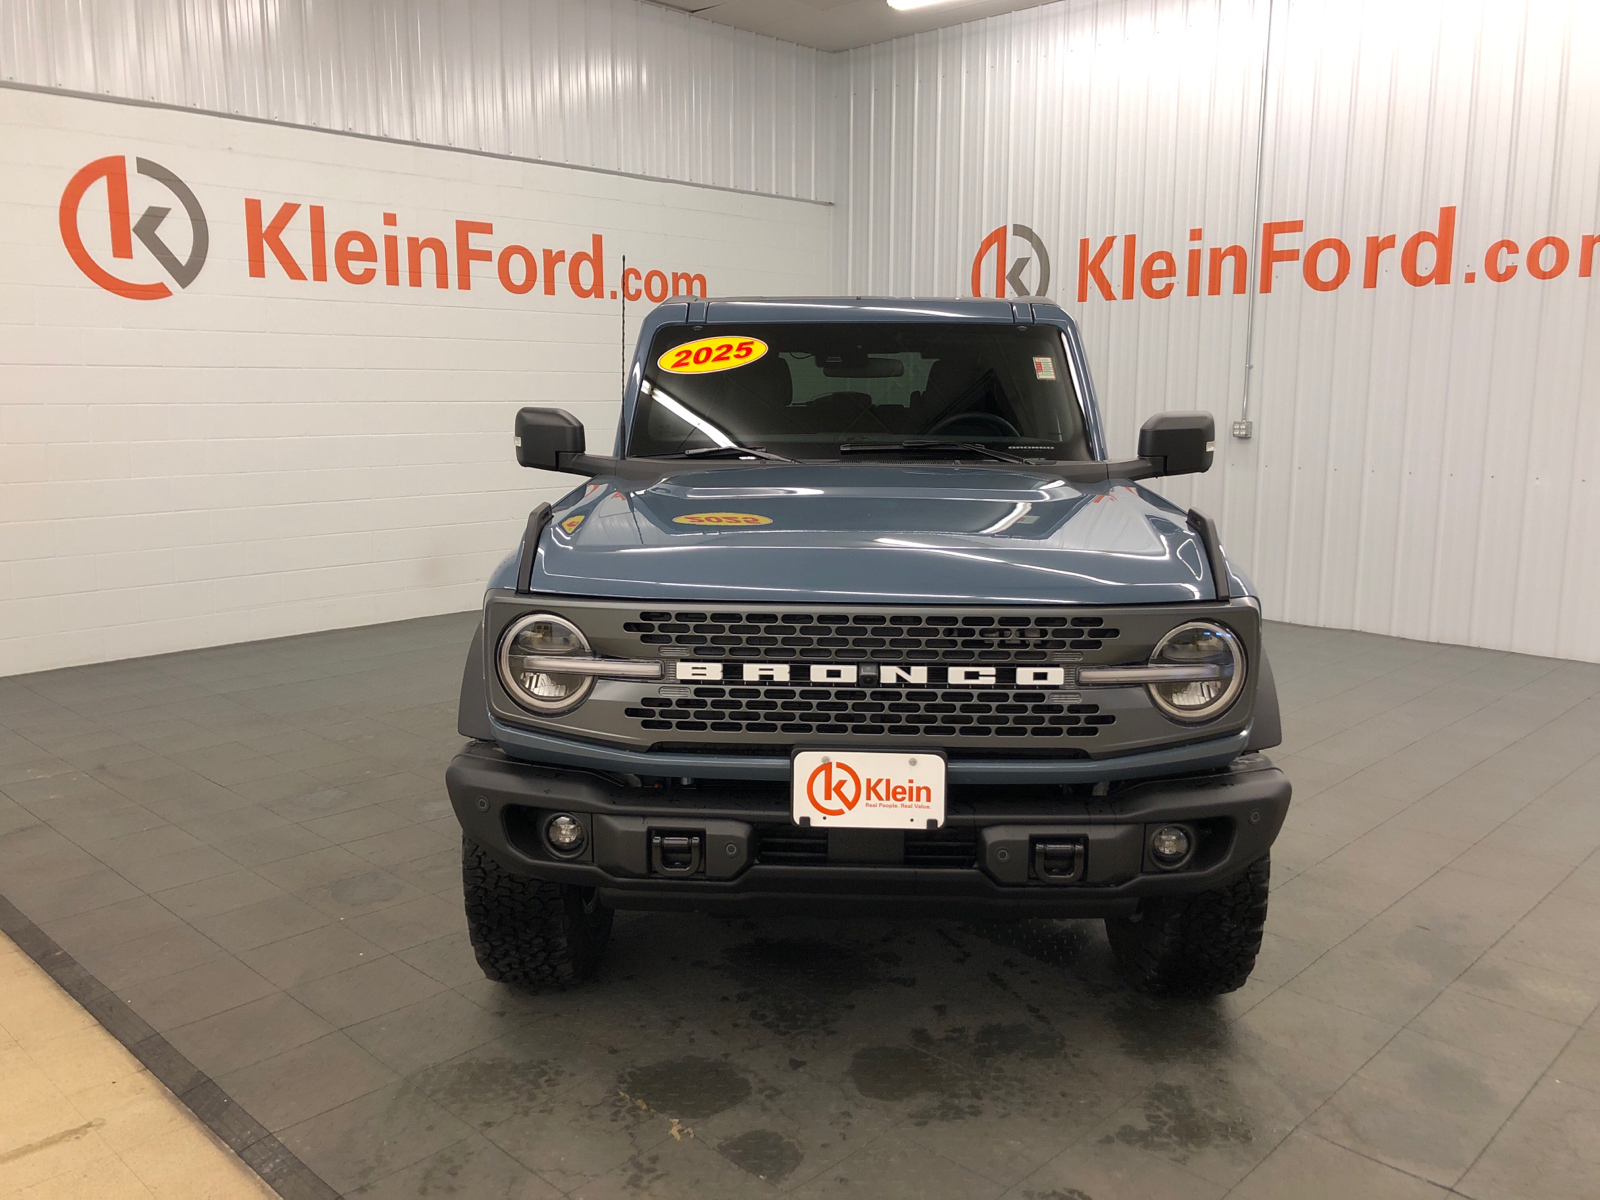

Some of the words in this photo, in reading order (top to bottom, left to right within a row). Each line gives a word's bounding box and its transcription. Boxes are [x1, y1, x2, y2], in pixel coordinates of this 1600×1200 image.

[244, 197, 707, 303] KleinFord.com
[670, 341, 755, 369] 2025
[676, 662, 1064, 686] BRONCO
[865, 778, 932, 802] Klein
